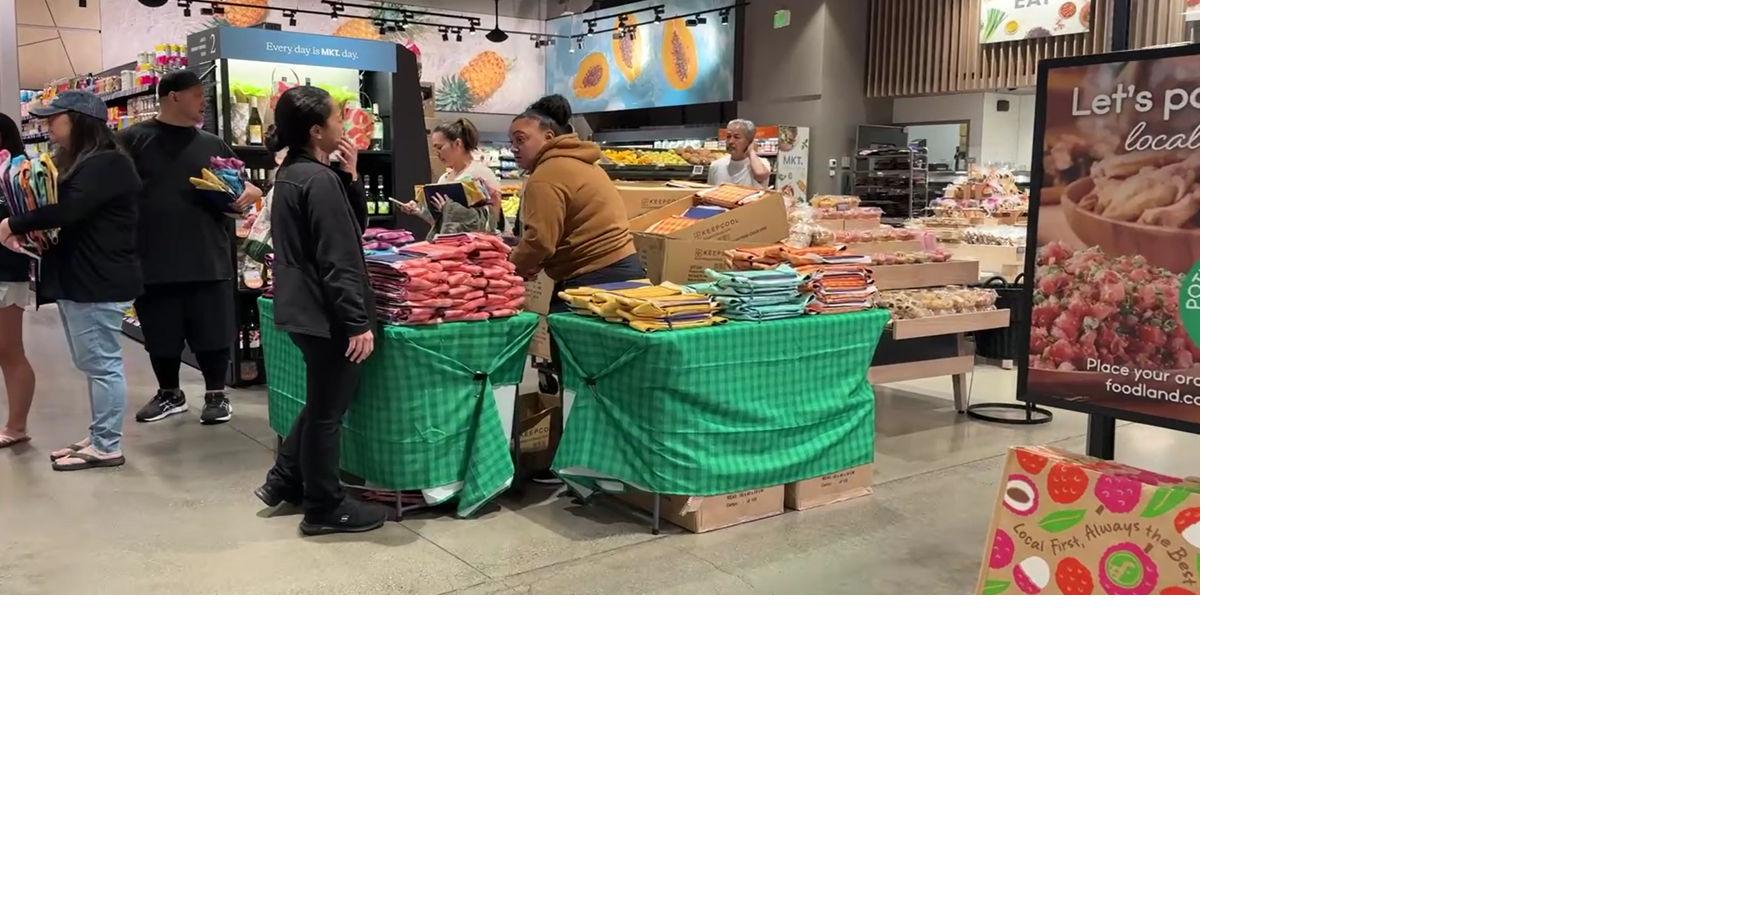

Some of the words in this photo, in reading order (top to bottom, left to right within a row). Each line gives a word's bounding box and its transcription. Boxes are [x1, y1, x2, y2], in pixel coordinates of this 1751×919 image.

[210, 33, 217, 54] 2
[266, 41, 293, 55] Every
[294, 45, 311, 57] day
[312, 46, 320, 55] is
[321, 47, 340, 57] MKT.
[341, 49, 359, 60] day.
[1071, 83, 1153, 117] Let's
[782, 155, 803, 166] MKT.
[701, 218, 739, 236] KEEPCOOL
[1086, 357, 1130, 376] Place
[1134, 367, 1171, 382] your
[1013, 523, 1044, 552] Local
[1050, 535, 1085, 556] First,
[1084, 521, 1140, 541] Always
[1145, 525, 1171, 548] the
[1166, 546, 1197, 586] Best
